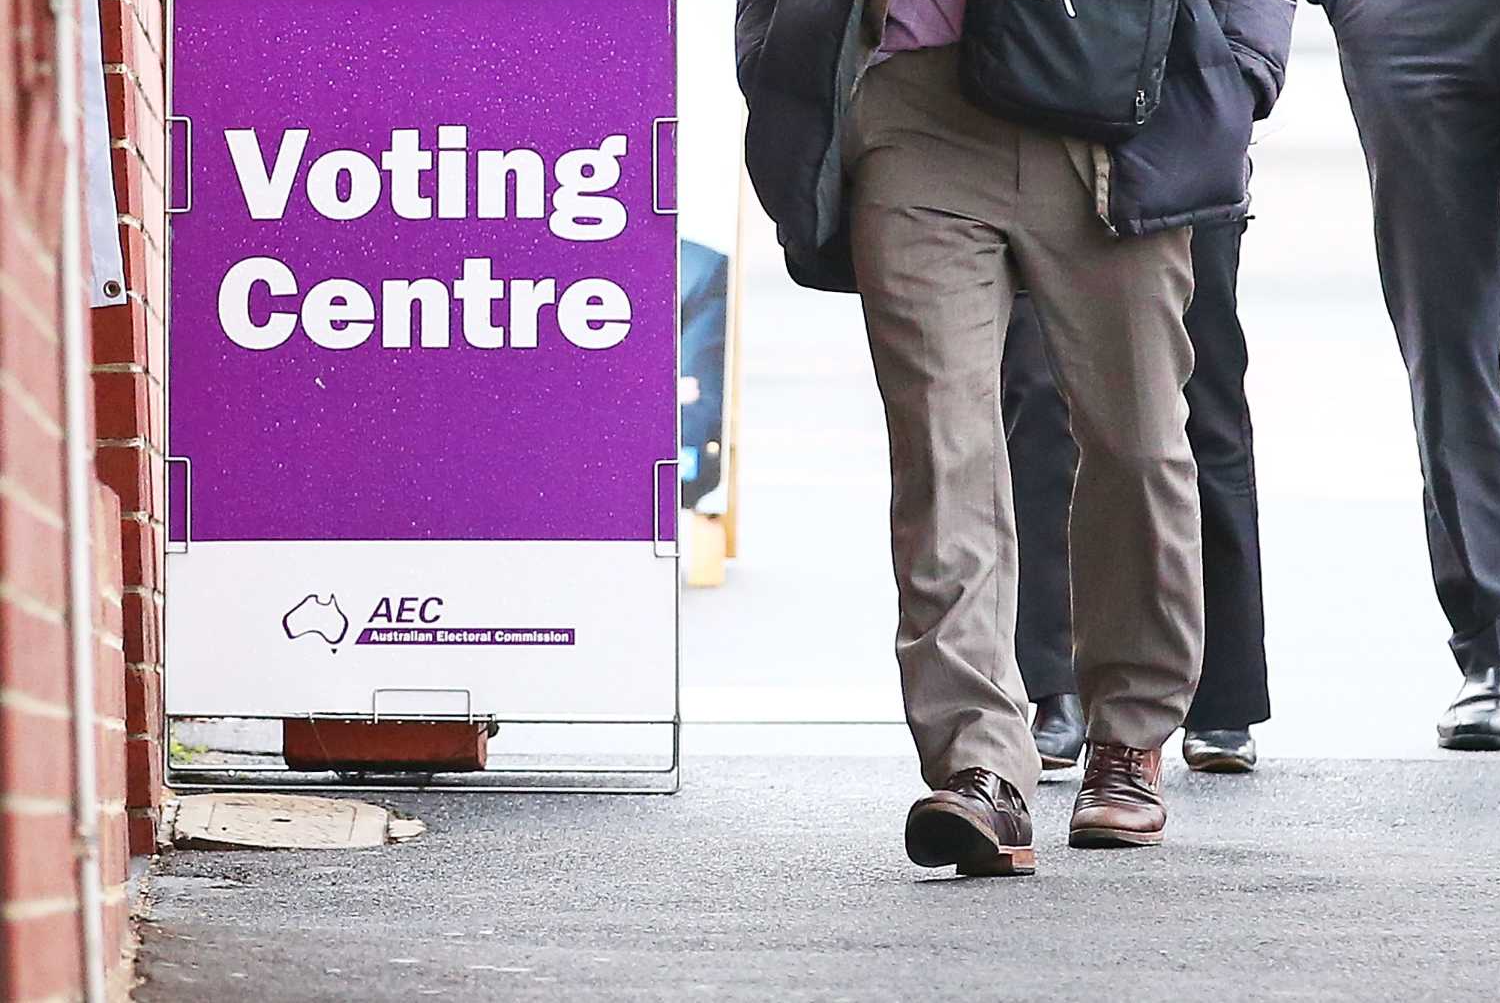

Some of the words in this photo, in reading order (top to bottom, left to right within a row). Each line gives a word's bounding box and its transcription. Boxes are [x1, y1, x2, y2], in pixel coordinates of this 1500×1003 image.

[224, 126, 628, 242] Voting
[217, 256, 632, 350] Centre
[368, 597, 443, 623] AEC
[370, 630, 433, 642] Australian
[436, 630, 491, 642] Electoral
[495, 630, 569, 643] Commission
